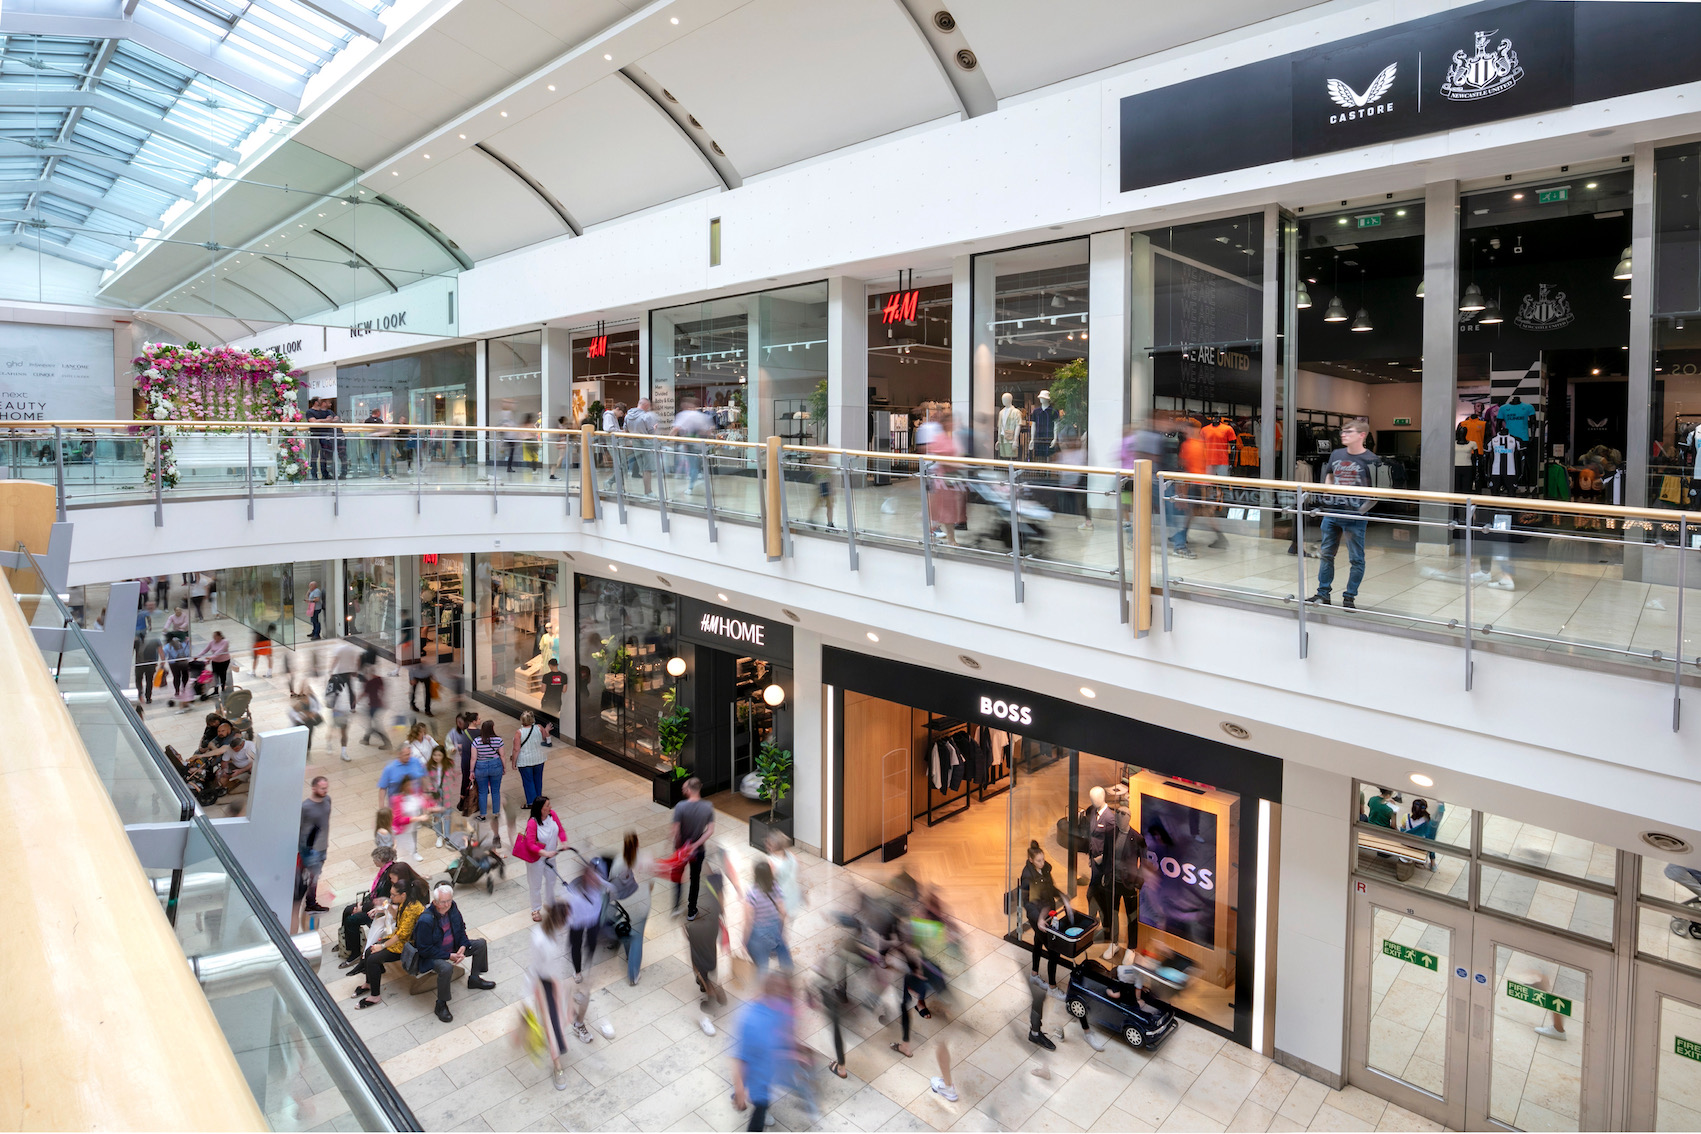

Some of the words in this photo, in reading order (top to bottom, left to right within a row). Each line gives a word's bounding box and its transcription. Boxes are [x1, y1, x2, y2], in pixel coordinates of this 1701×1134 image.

[1451, 89, 1488, 99] NEWCASTLE
[1488, 80, 1513, 94] UNITED
[1329, 102, 1394, 124] CASTORE
[882, 290, 920, 324] H&M
[350, 319, 372, 338] NEW
[376, 311, 407, 333] LOOK
[282, 340, 302, 354] LOOK
[588, 335, 608, 358] H&M
[6, 360, 23, 368] ghd
[1198, 345, 1215, 365] ARE
[1217, 349, 1250, 371] UNITED
[0, 411, 44, 420] HOME
[1332, 460, 1363, 472] Fender
[701, 613, 719, 635] H&M
[719, 616, 765, 646] HOME
[980, 696, 1032, 725] BOSS
[1146, 850, 1214, 890] BOSS
[1357, 882, 1366, 893] R
[1384, 941, 1402, 950] FIRE
[1384, 947, 1402, 958] EXIT
[1508, 982, 1528, 994] FIRE
[1508, 989, 1529, 1000] EXIT
[1677, 1039, 1701, 1051] FIRE
[1676, 1046, 1701, 1060] EXIT
